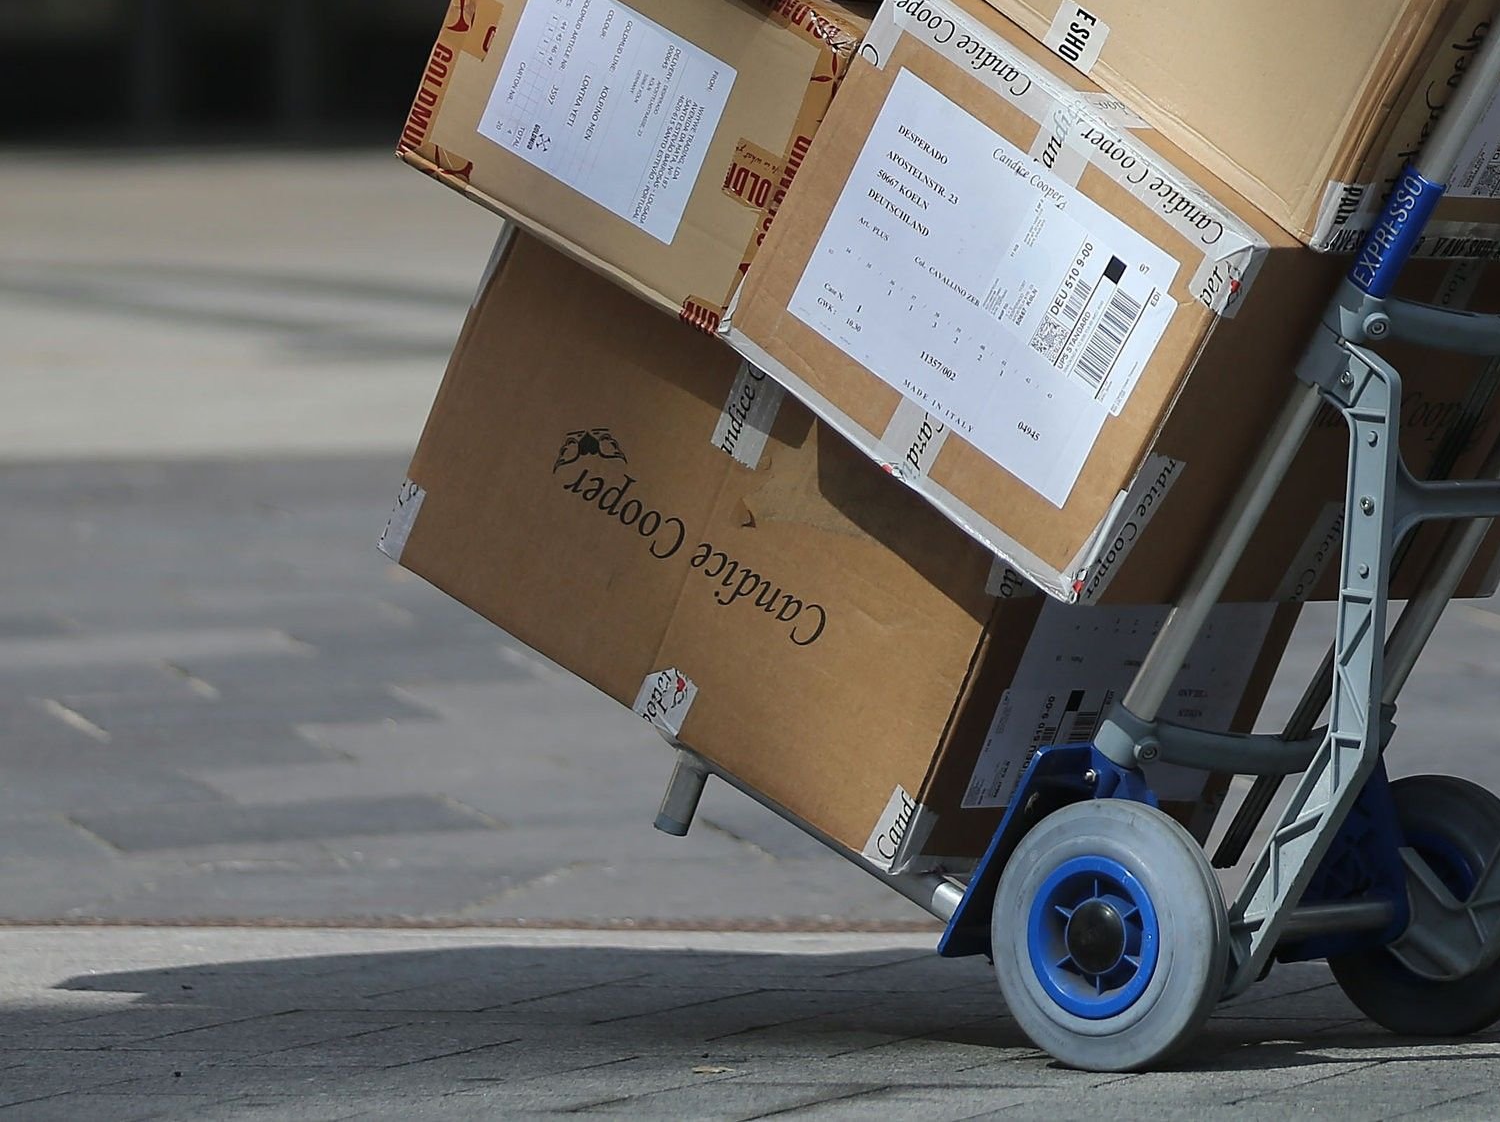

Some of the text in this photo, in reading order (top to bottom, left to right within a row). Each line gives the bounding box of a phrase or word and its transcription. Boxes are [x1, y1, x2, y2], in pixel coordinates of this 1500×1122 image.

[563, 29, 578, 58] ARTICLE
[615, 20, 633, 54] GOLDMUD
[661, 44, 674, 69] 000645
[957, 34, 1032, 96] Candice
[495, 61, 526, 130] CARTON 20
[546, 84, 558, 105] 3597
[566, 9, 614, 127] COLOUR: LONTRA YETI
[583, 121, 595, 141] MEN
[591, 85, 609, 121] KOLPINO
[690, 105, 704, 132] WHYWE
[512, 125, 525, 148] TOTAL
[631, 93, 685, 220] 4620-615 SANTO ESTEVÃO PORTUGAL
[638, 97, 691, 224] SANTO ESTEVÃO BARROSAS LOUSADA
[660, 101, 698, 189] AVENIDA DA 187
[897, 124, 948, 165] DESPERADO
[671, 165, 681, 180] LDA
[876, 168, 929, 211] 50667 KOELN
[885, 149, 959, 206] APOSTELNSTR. 23
[991, 144, 1064, 206] Candice Cooper
[1080, 130, 1224, 245] Candice Cooper
[867, 188, 929, 237] DEUTSCHLAND
[1353, 175, 1423, 288] EXPRESSO
[872, 225, 889, 241] PLUS
[928, 266, 966, 297] CAVALLINO
[1048, 241, 1095, 316] DEU 510 9-00
[1138, 262, 1149, 275] 07
[1149, 291, 1163, 307] EDI
[1055, 310, 1093, 369] UPS STANDARD
[902, 378, 974, 434] MADE IN ITALY
[919, 349, 1040, 442] 11357/002 04945
[563, 468, 827, 647] Candice Cooper
[1087, 521, 1138, 599] Cooper
